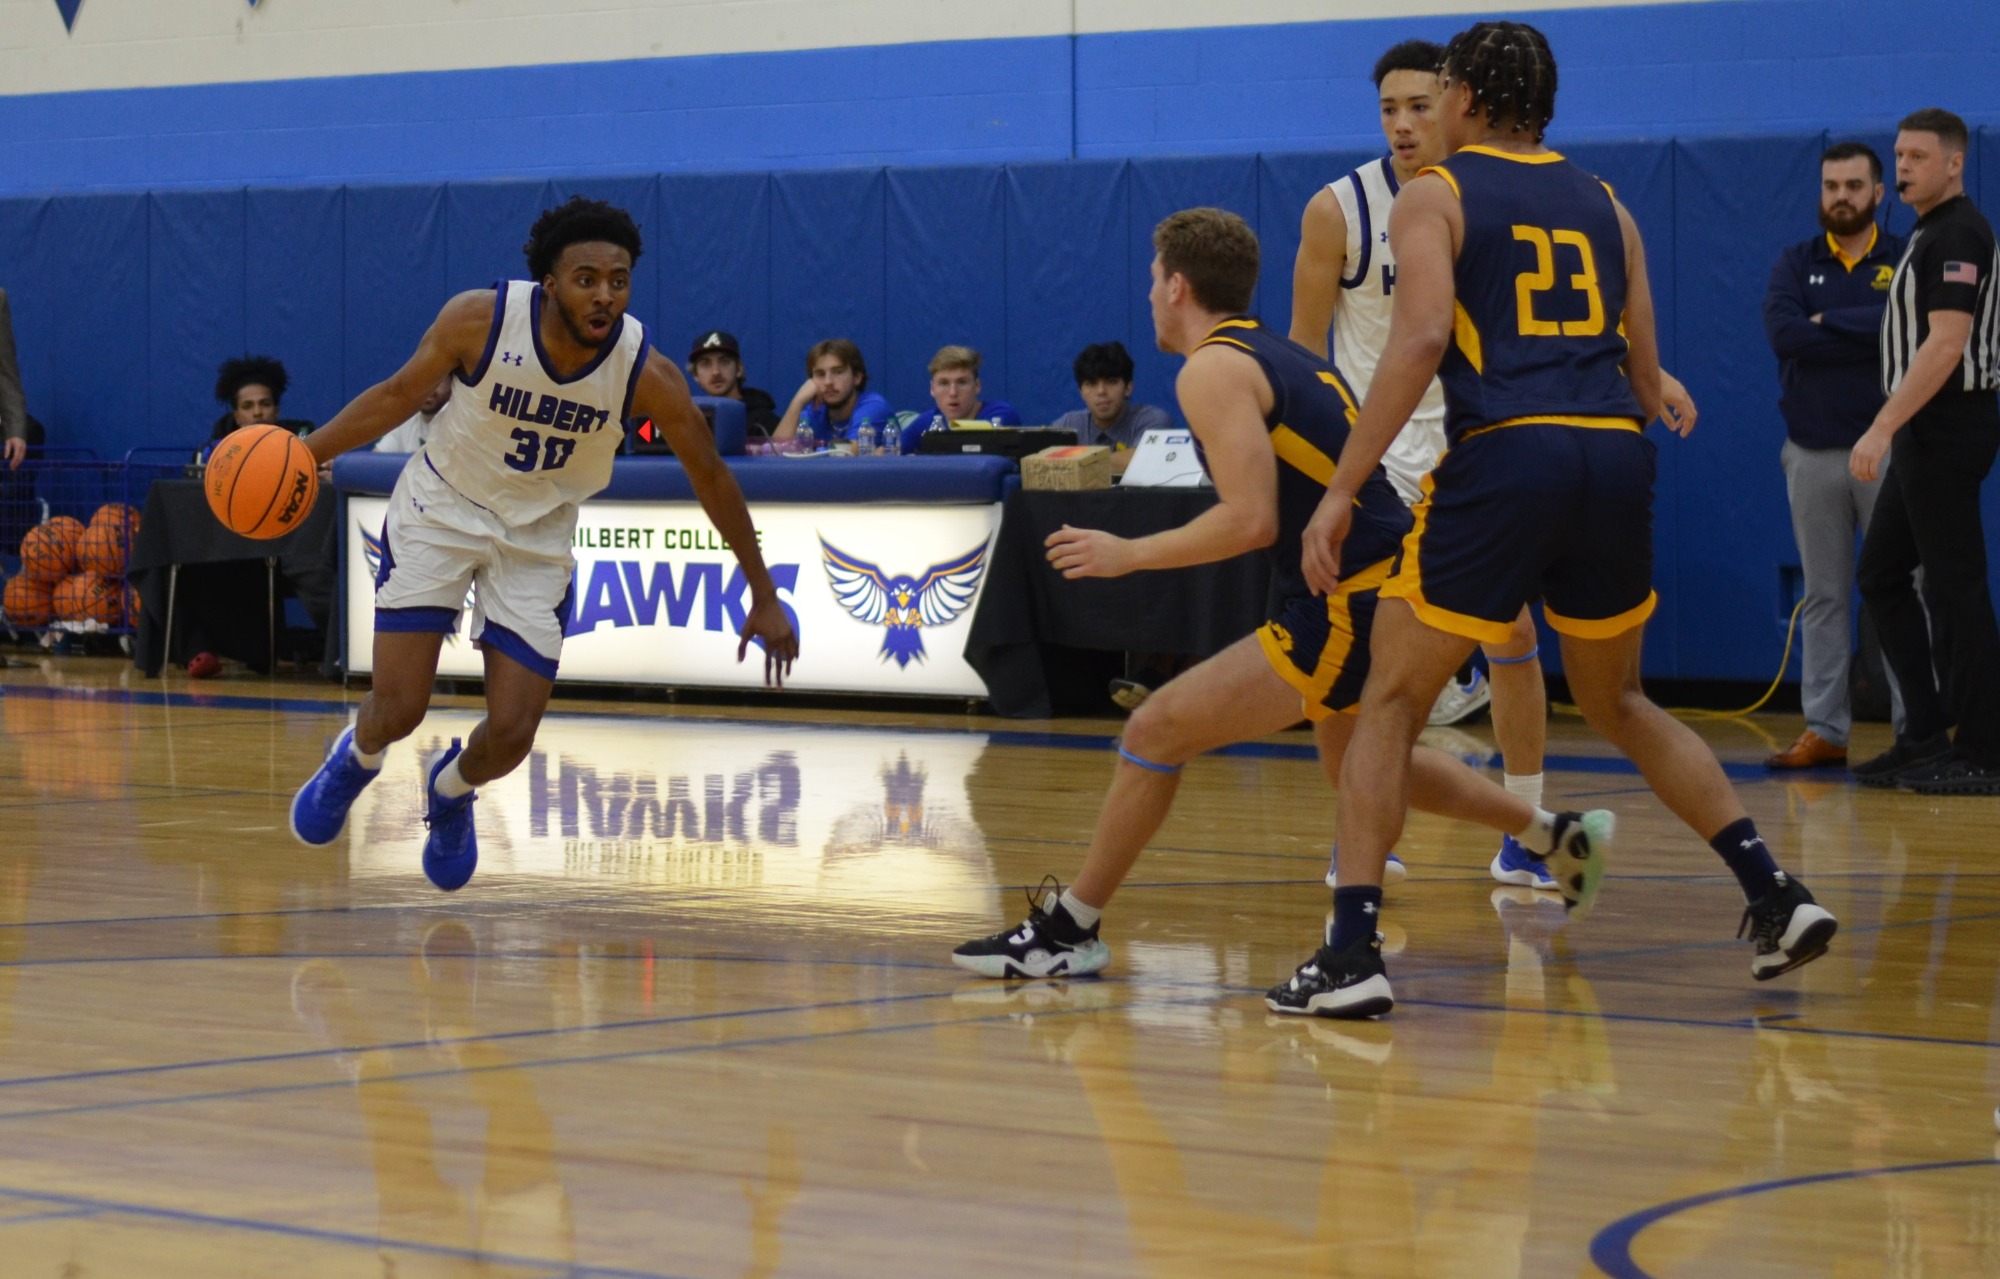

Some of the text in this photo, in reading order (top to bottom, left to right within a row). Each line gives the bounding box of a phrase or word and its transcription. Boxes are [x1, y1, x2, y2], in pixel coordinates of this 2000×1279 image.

[1511, 225, 1604, 336] 23
[703, 332, 720, 348] A
[489, 382, 610, 433] HILBERT
[504, 427, 577, 472] 30
[278, 470, 309, 523] NCAA
